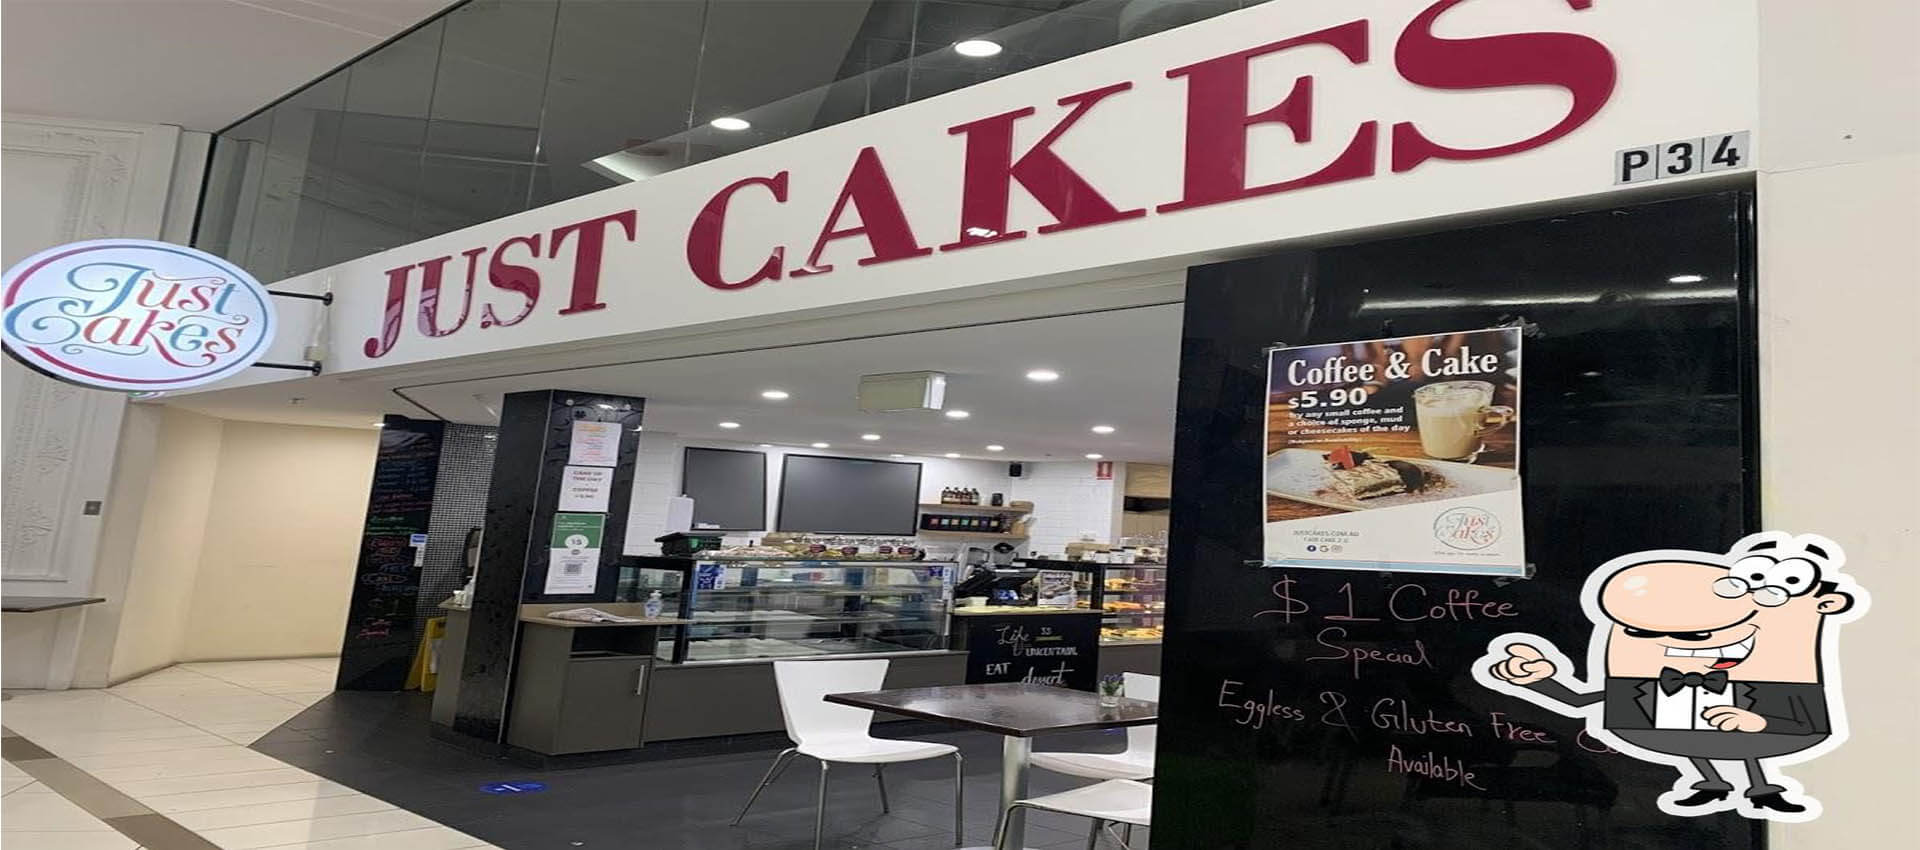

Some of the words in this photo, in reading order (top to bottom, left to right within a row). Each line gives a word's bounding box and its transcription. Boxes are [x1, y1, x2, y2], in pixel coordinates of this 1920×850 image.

[364, 209, 637, 358] JUST
[686, 0, 1617, 291] CAKES
[1622, 135, 1740, 182] P34
[67, 262, 241, 317] Just
[4, 297, 247, 368] Cakes
[1288, 355, 1375, 387] Coffee
[1385, 351, 1412, 380] &
[1423, 346, 1498, 377] Cake
[1288, 387, 1368, 409] $5.90
[1305, 411, 1323, 419] any
[1325, 409, 1350, 417] small
[1352, 407, 1381, 416] coffee
[1384, 406, 1404, 414] and
[1296, 418, 1325, 426] choice
[1341, 417, 1378, 427] sponge,
[1380, 415, 1403, 423] mud
[1300, 426, 1357, 435] cheesecakes
[1391, 424, 1411, 433] day
[1389, 583, 1519, 621] Coffee
[986, 661, 1012, 676] EAT
[1306, 627, 1434, 679] Special
[1218, 679, 1304, 730] Eggless
[1371, 698, 1472, 738] Gluten
[1490, 711, 1557, 744] Free
[1388, 744, 1487, 791] Available
